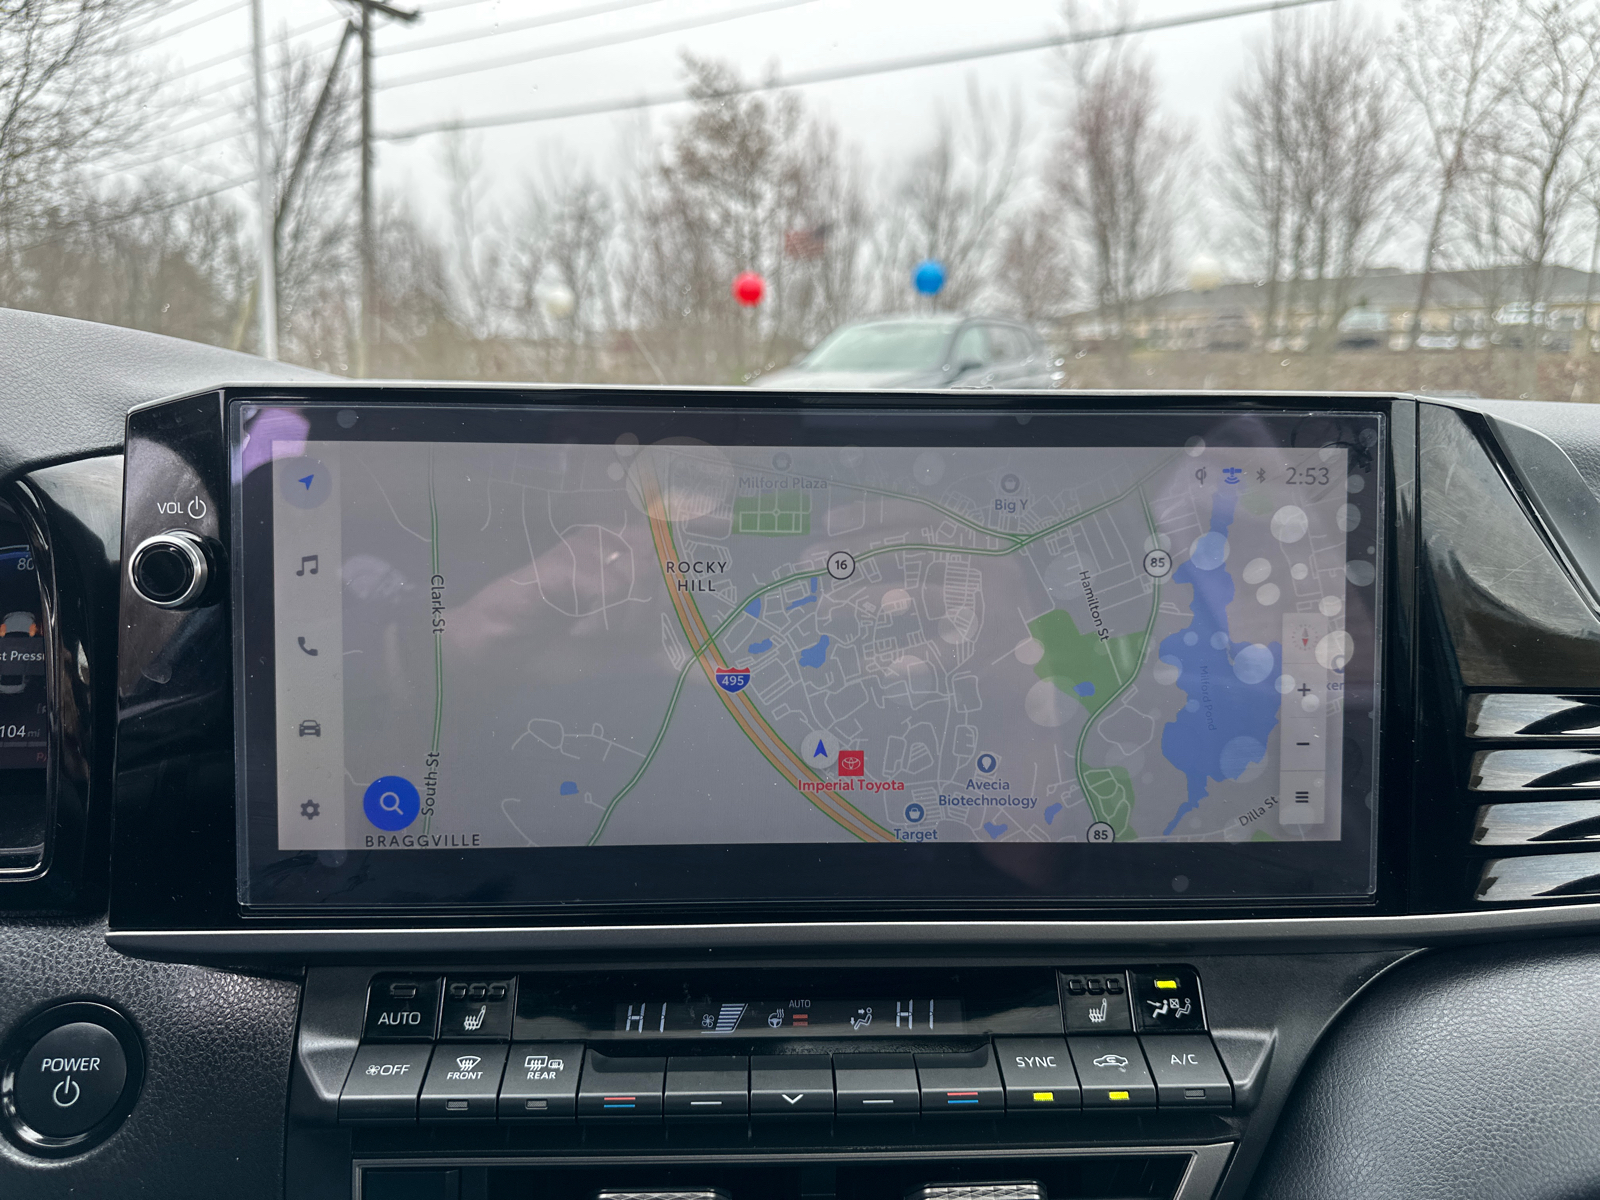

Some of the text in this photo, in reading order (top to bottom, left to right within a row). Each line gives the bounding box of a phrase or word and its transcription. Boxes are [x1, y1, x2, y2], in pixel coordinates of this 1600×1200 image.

[1286, 467, 1330, 485] 2:53
[738, 477, 828, 490] Milford Plaza
[157, 502, 184, 514] VOL
[994, 498, 1029, 514] Big Y
[666, 561, 728, 574] ROCKY
[834, 560, 848, 570] 16
[1149, 557, 1165, 568] 85
[677, 580, 716, 592] HILL
[430, 574, 446, 635] Clark St
[1078, 570, 1110, 641] Hamilton St
[721, 675, 745, 687] 495
[1205, 705, 1217, 731] Pond
[421, 752, 440, 817] South St
[798, 779, 905, 794] Imperial Toyota
[966, 778, 1010, 791] Avecia
[938, 794, 1038, 809] Biotechnology
[1238, 795, 1279, 827] Dilla St
[365, 834, 481, 848] BRAGGVILLE
[894, 828, 938, 843] Target
[1093, 830, 1108, 840] 85
[788, 999, 811, 1009] AUTO
[378, 1011, 421, 1026] AUTO
[41, 1057, 101, 1072] POWER
[1015, 1056, 1057, 1068] SYNC
[1170, 1053, 1198, 1066] A/C
[380, 1064, 411, 1076] OFF
[446, 1070, 483, 1080] FRONT
[526, 1070, 556, 1080] REAR
